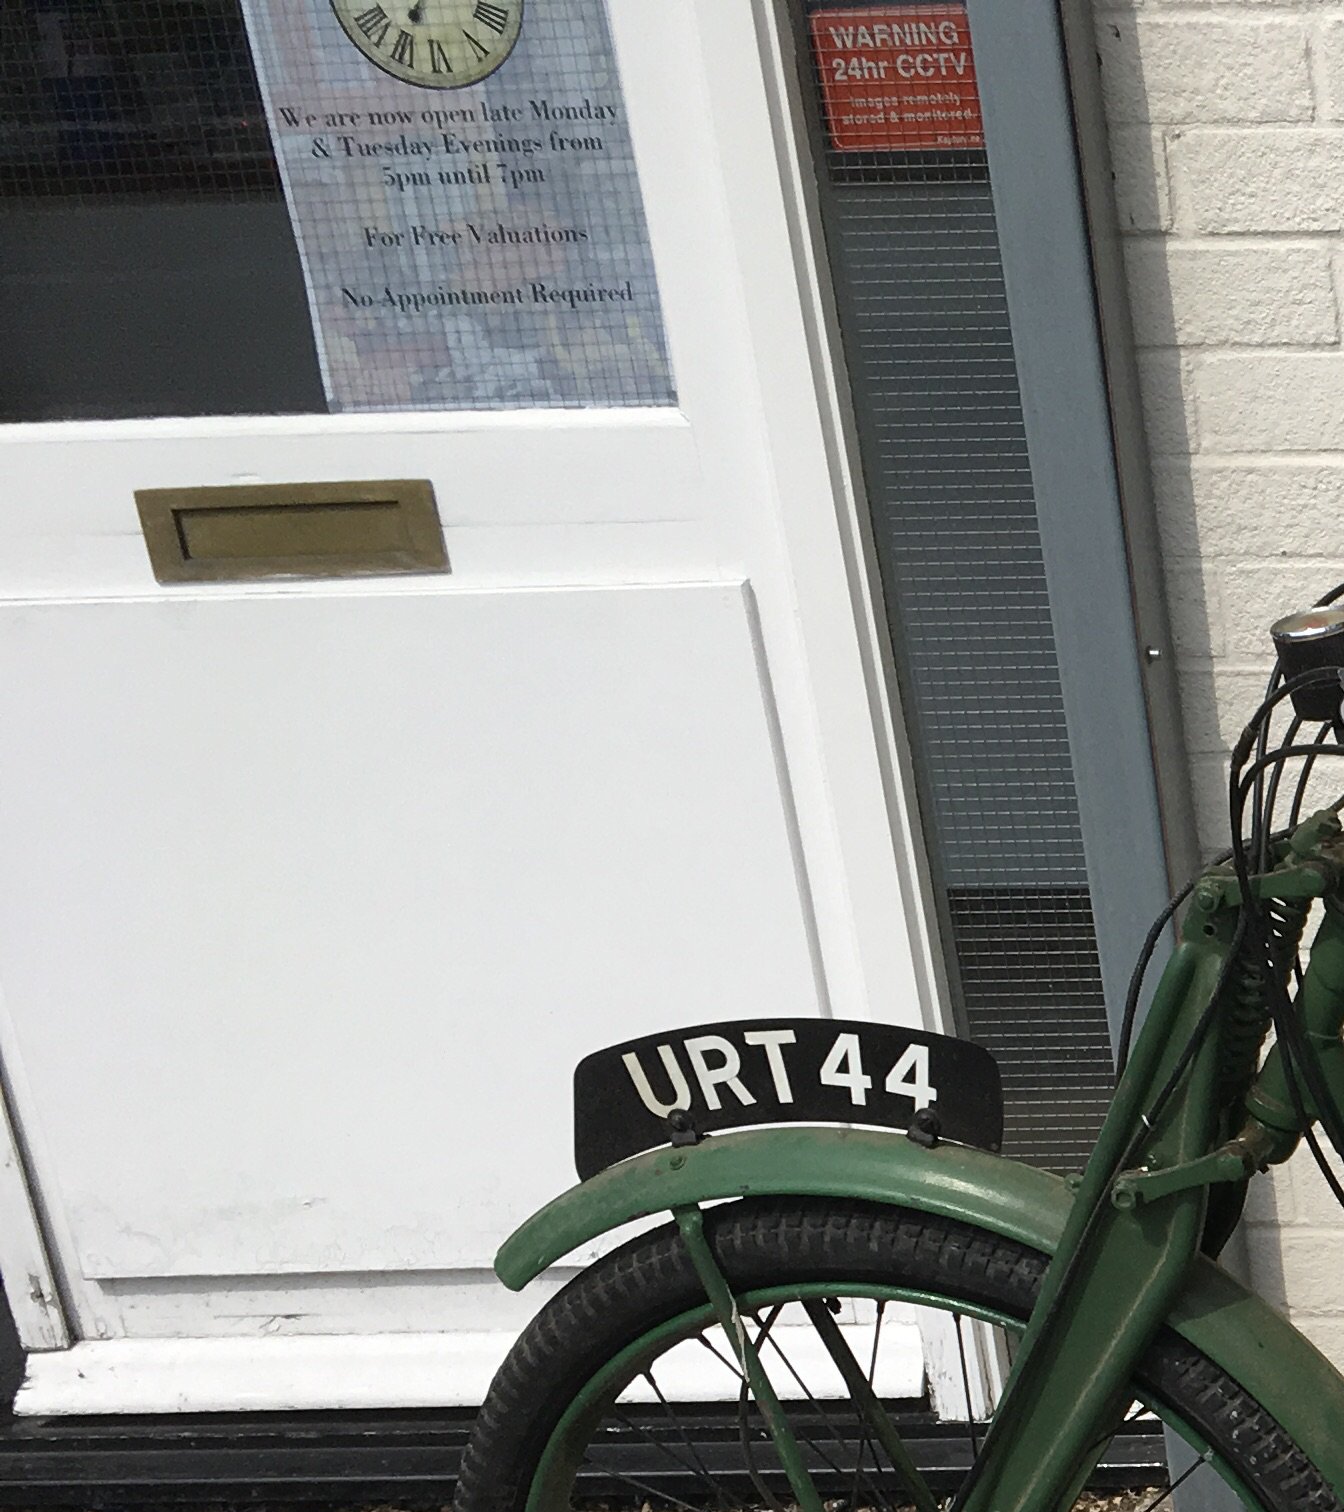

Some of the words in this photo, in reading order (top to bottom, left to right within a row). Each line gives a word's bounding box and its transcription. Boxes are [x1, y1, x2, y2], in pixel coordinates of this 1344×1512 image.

[829, 21, 960, 49] WARNING
[832, 56, 888, 81] 24hr
[896, 52, 966, 78] CCTV
[279, 107, 317, 127] We
[325, 112, 360, 127] are
[368, 111, 412, 125] now
[421, 108, 475, 130] open
[480, 101, 523, 122] late
[529, 99, 618, 126] Monday
[312, 136, 331, 159] &
[337, 134, 432, 160] Tuesday
[441, 132, 543, 158] Evenings
[549, 130, 604, 151] from
[383, 166, 432, 192] 5pm
[437, 163, 491, 185] until
[496, 163, 546, 189] 7pm
[364, 226, 405, 247] For
[411, 225, 462, 246] Free
[466, 223, 589, 245] Valuations
[341, 287, 373, 308] No
[382, 286, 524, 313] Appointment
[530, 281, 634, 309] Required
[622, 1029, 797, 1120] URT
[819, 1033, 938, 1113] 44
